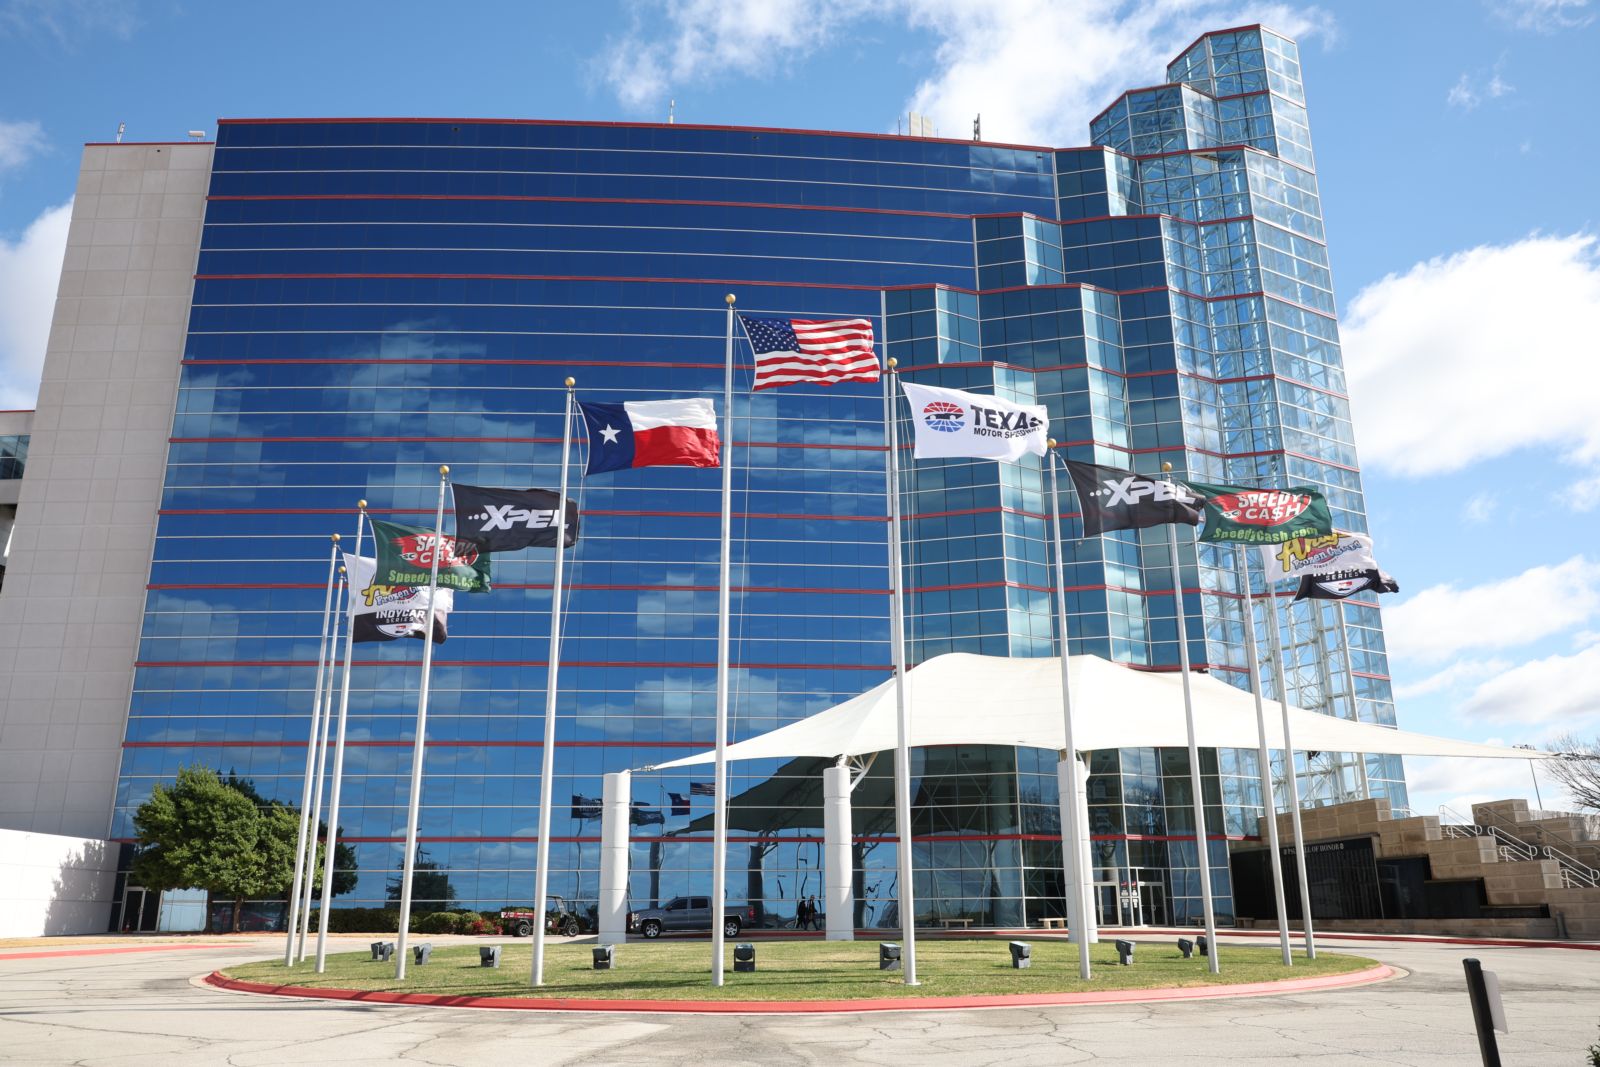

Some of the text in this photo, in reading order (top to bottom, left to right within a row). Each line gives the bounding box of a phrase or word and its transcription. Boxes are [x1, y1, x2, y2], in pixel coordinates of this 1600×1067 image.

[974, 427, 1002, 438] MOTOR
[1103, 476, 1196, 508] XPEL
[1236, 492, 1302, 508] SPEEDY
[480, 505, 570, 532] XPEL
[1213, 527, 1318, 542] SpeedyCash.com
[1326, 572, 1359, 581] SERIES
[376, 609, 426, 619] INDYCAR
